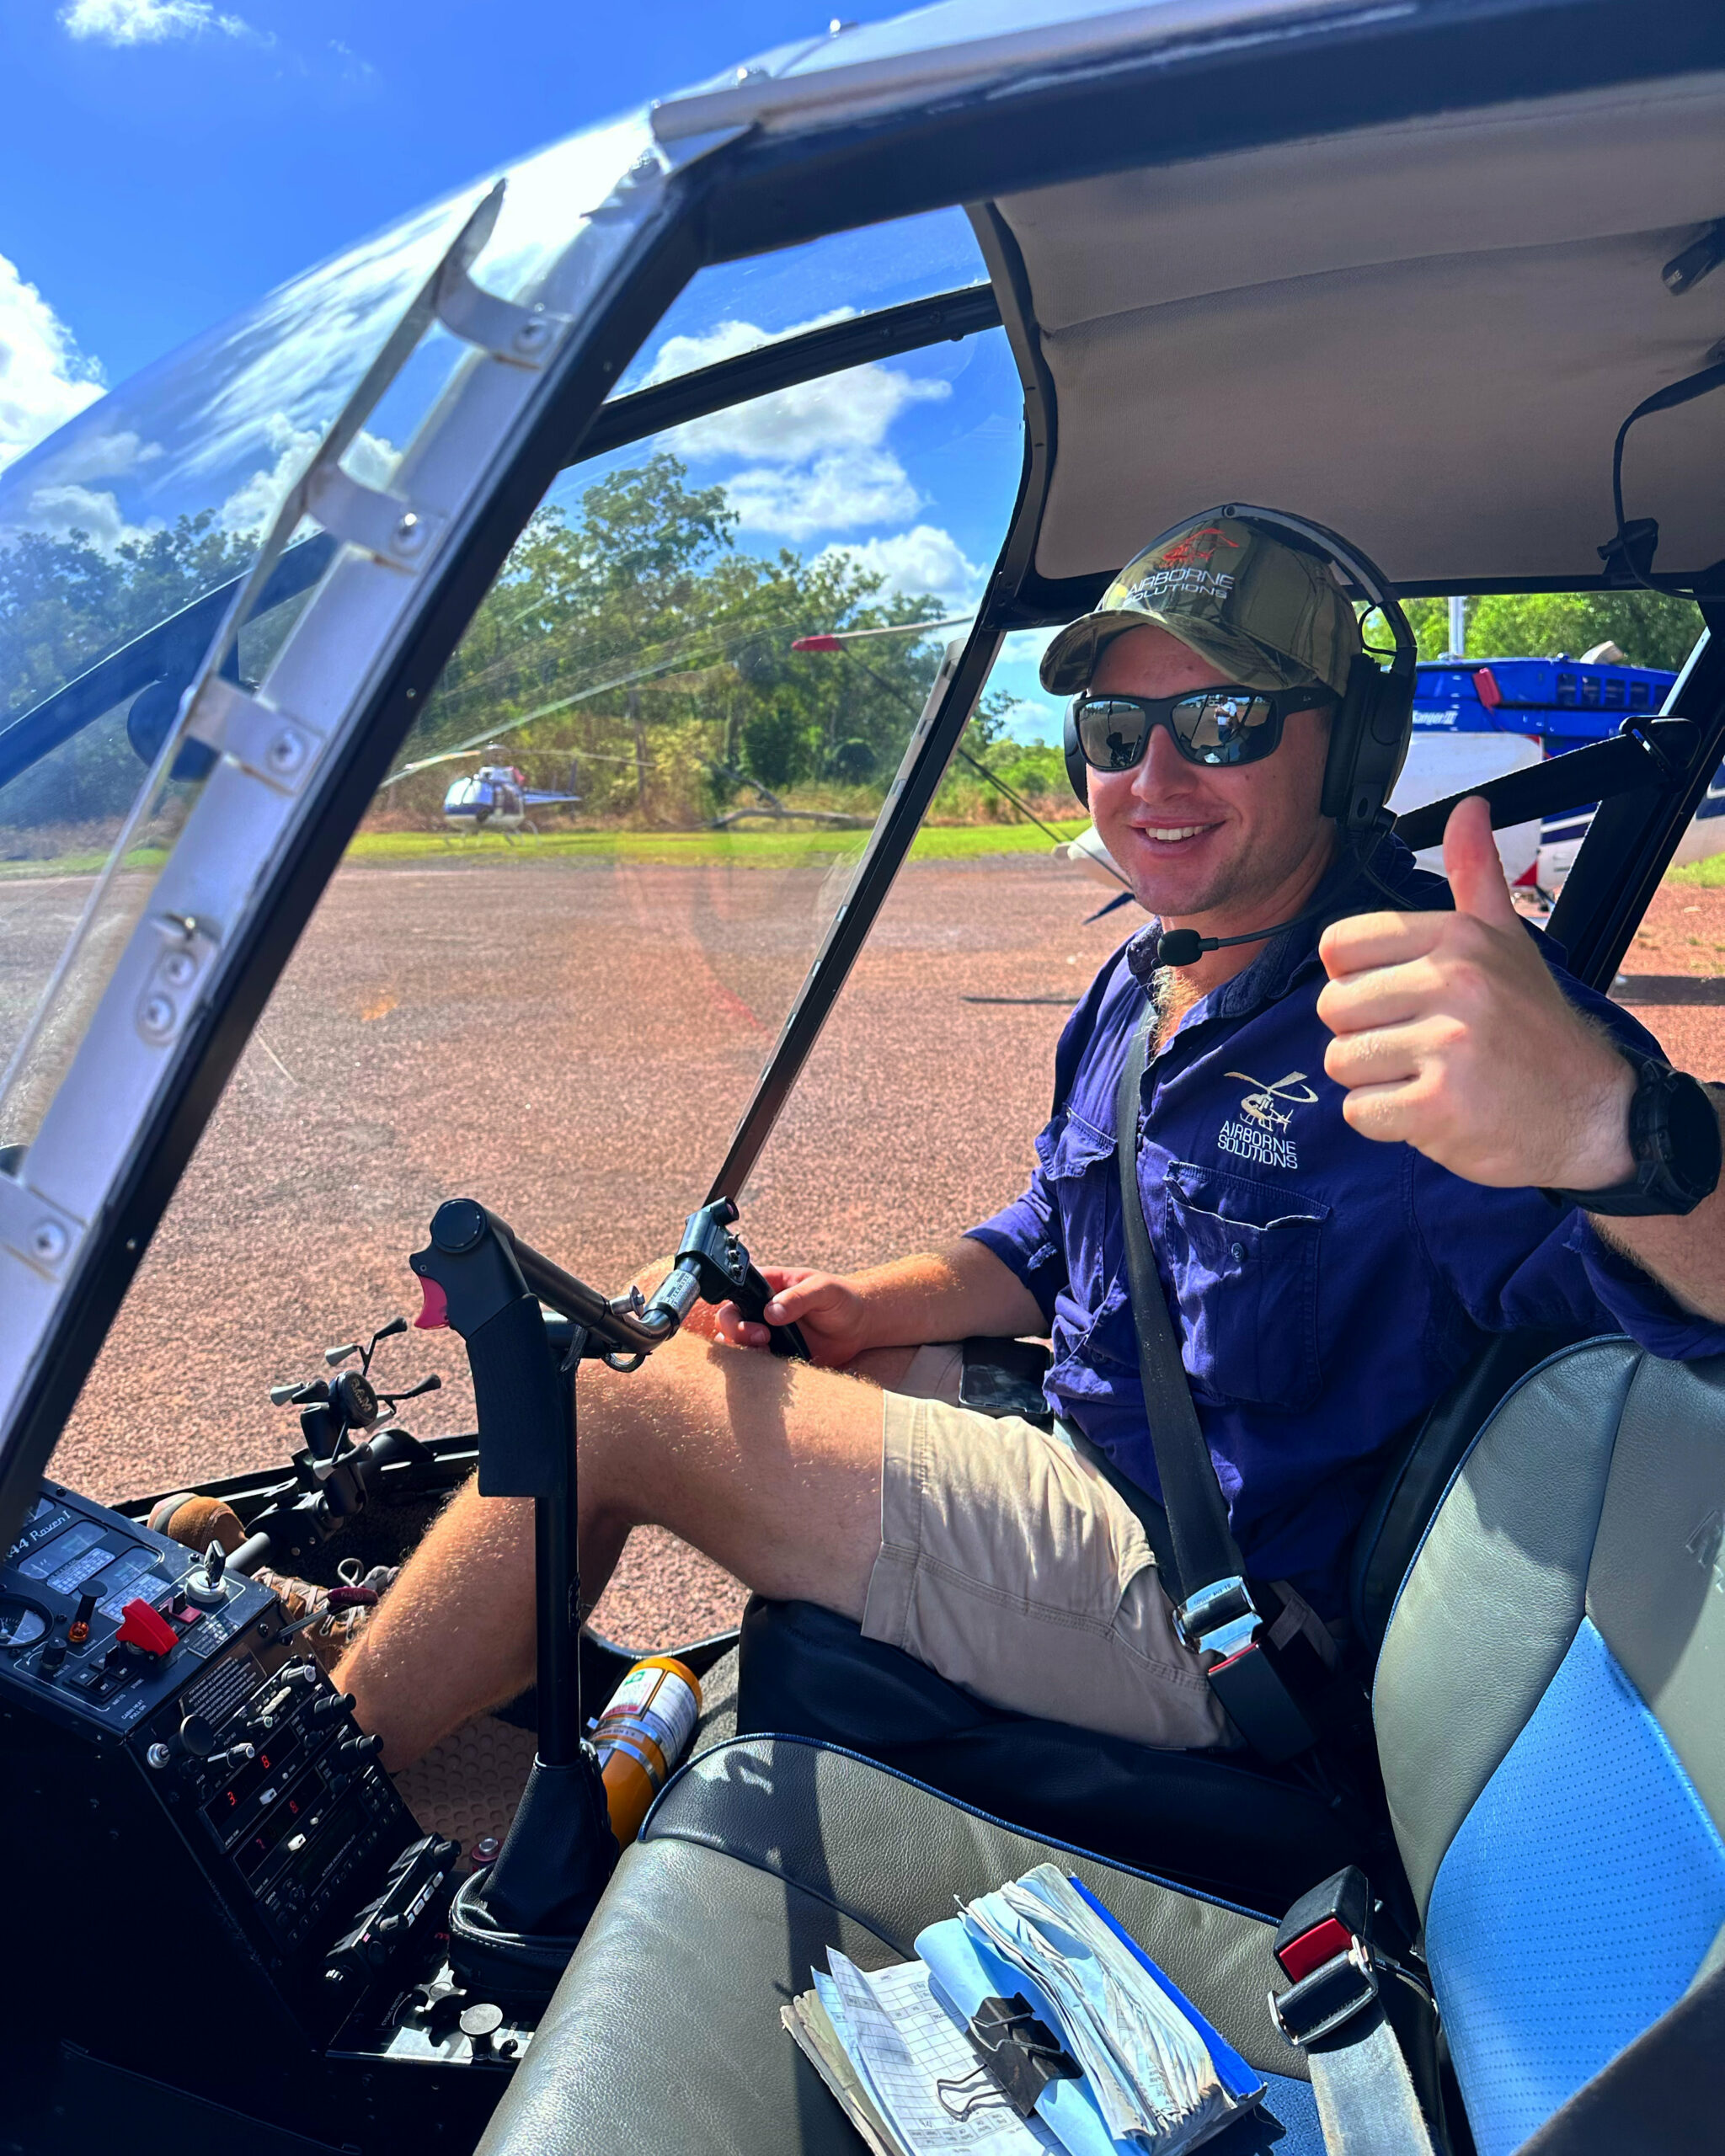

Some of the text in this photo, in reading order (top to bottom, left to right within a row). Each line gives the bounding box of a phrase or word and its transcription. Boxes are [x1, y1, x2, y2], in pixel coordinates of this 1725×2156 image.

[1122, 583, 1228, 607] SOLUTIONS
[1127, 568, 1236, 597] AIRBORNE
[1217, 1134, 1298, 1170] SOLUTIONS
[1220, 1120, 1297, 1156] AIRBORNE
[6, 1537, 29, 1558] 44
[29, 1515, 67, 1541] Raven
